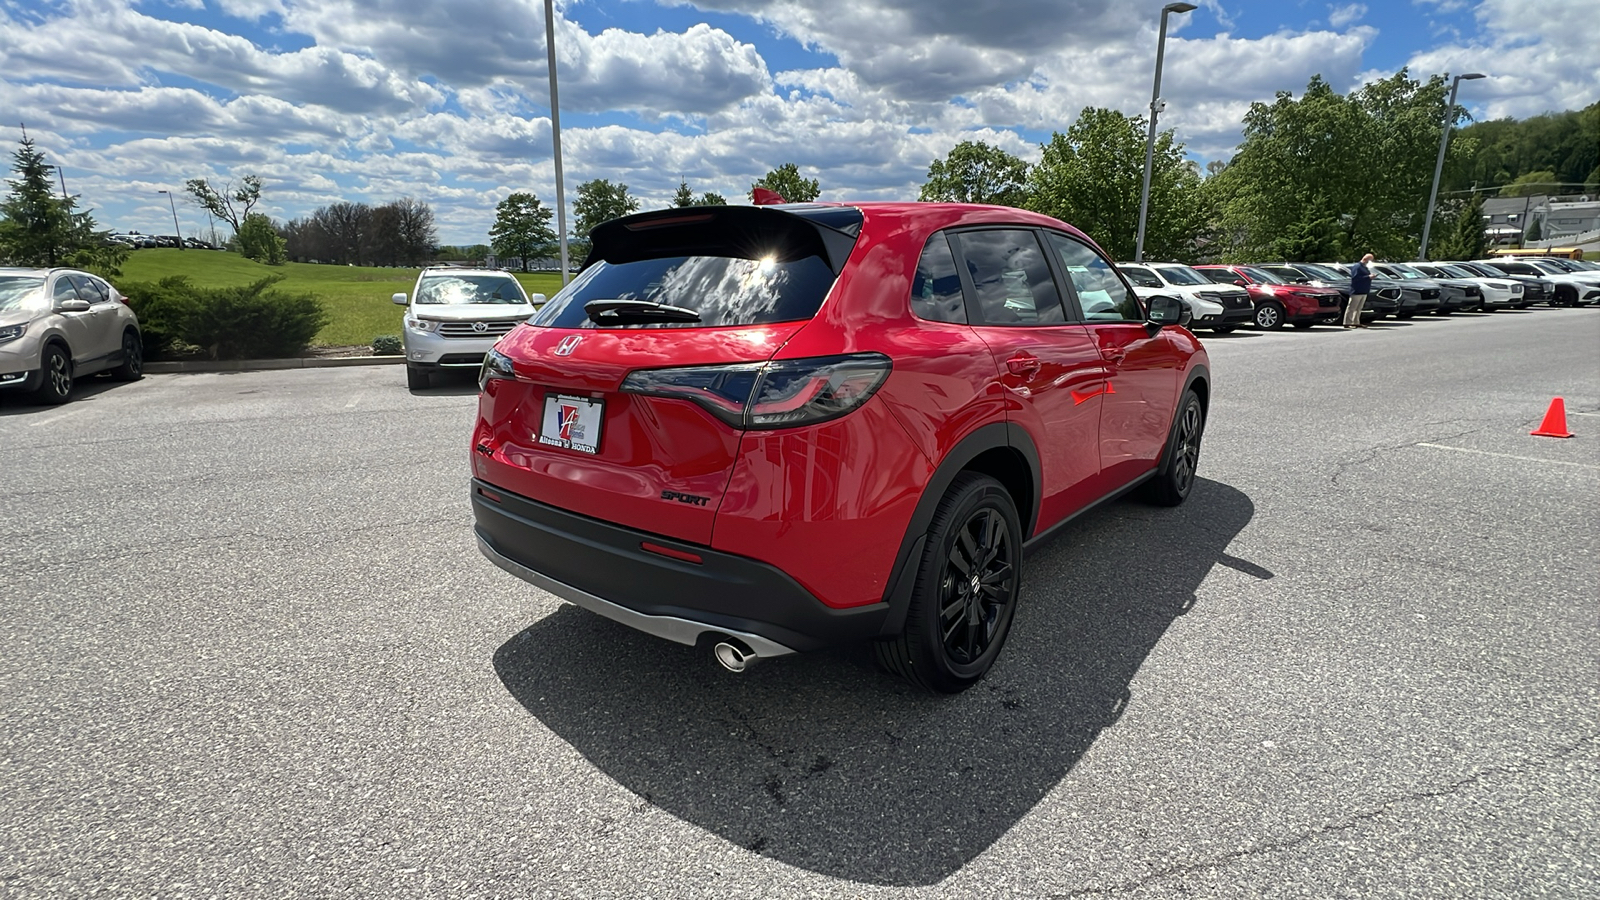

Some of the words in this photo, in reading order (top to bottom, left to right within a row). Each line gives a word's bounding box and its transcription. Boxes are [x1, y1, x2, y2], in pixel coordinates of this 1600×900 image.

[539, 435, 562, 448] Altoona
[571, 442, 596, 454] HONDA
[661, 489, 711, 507] SPORT
